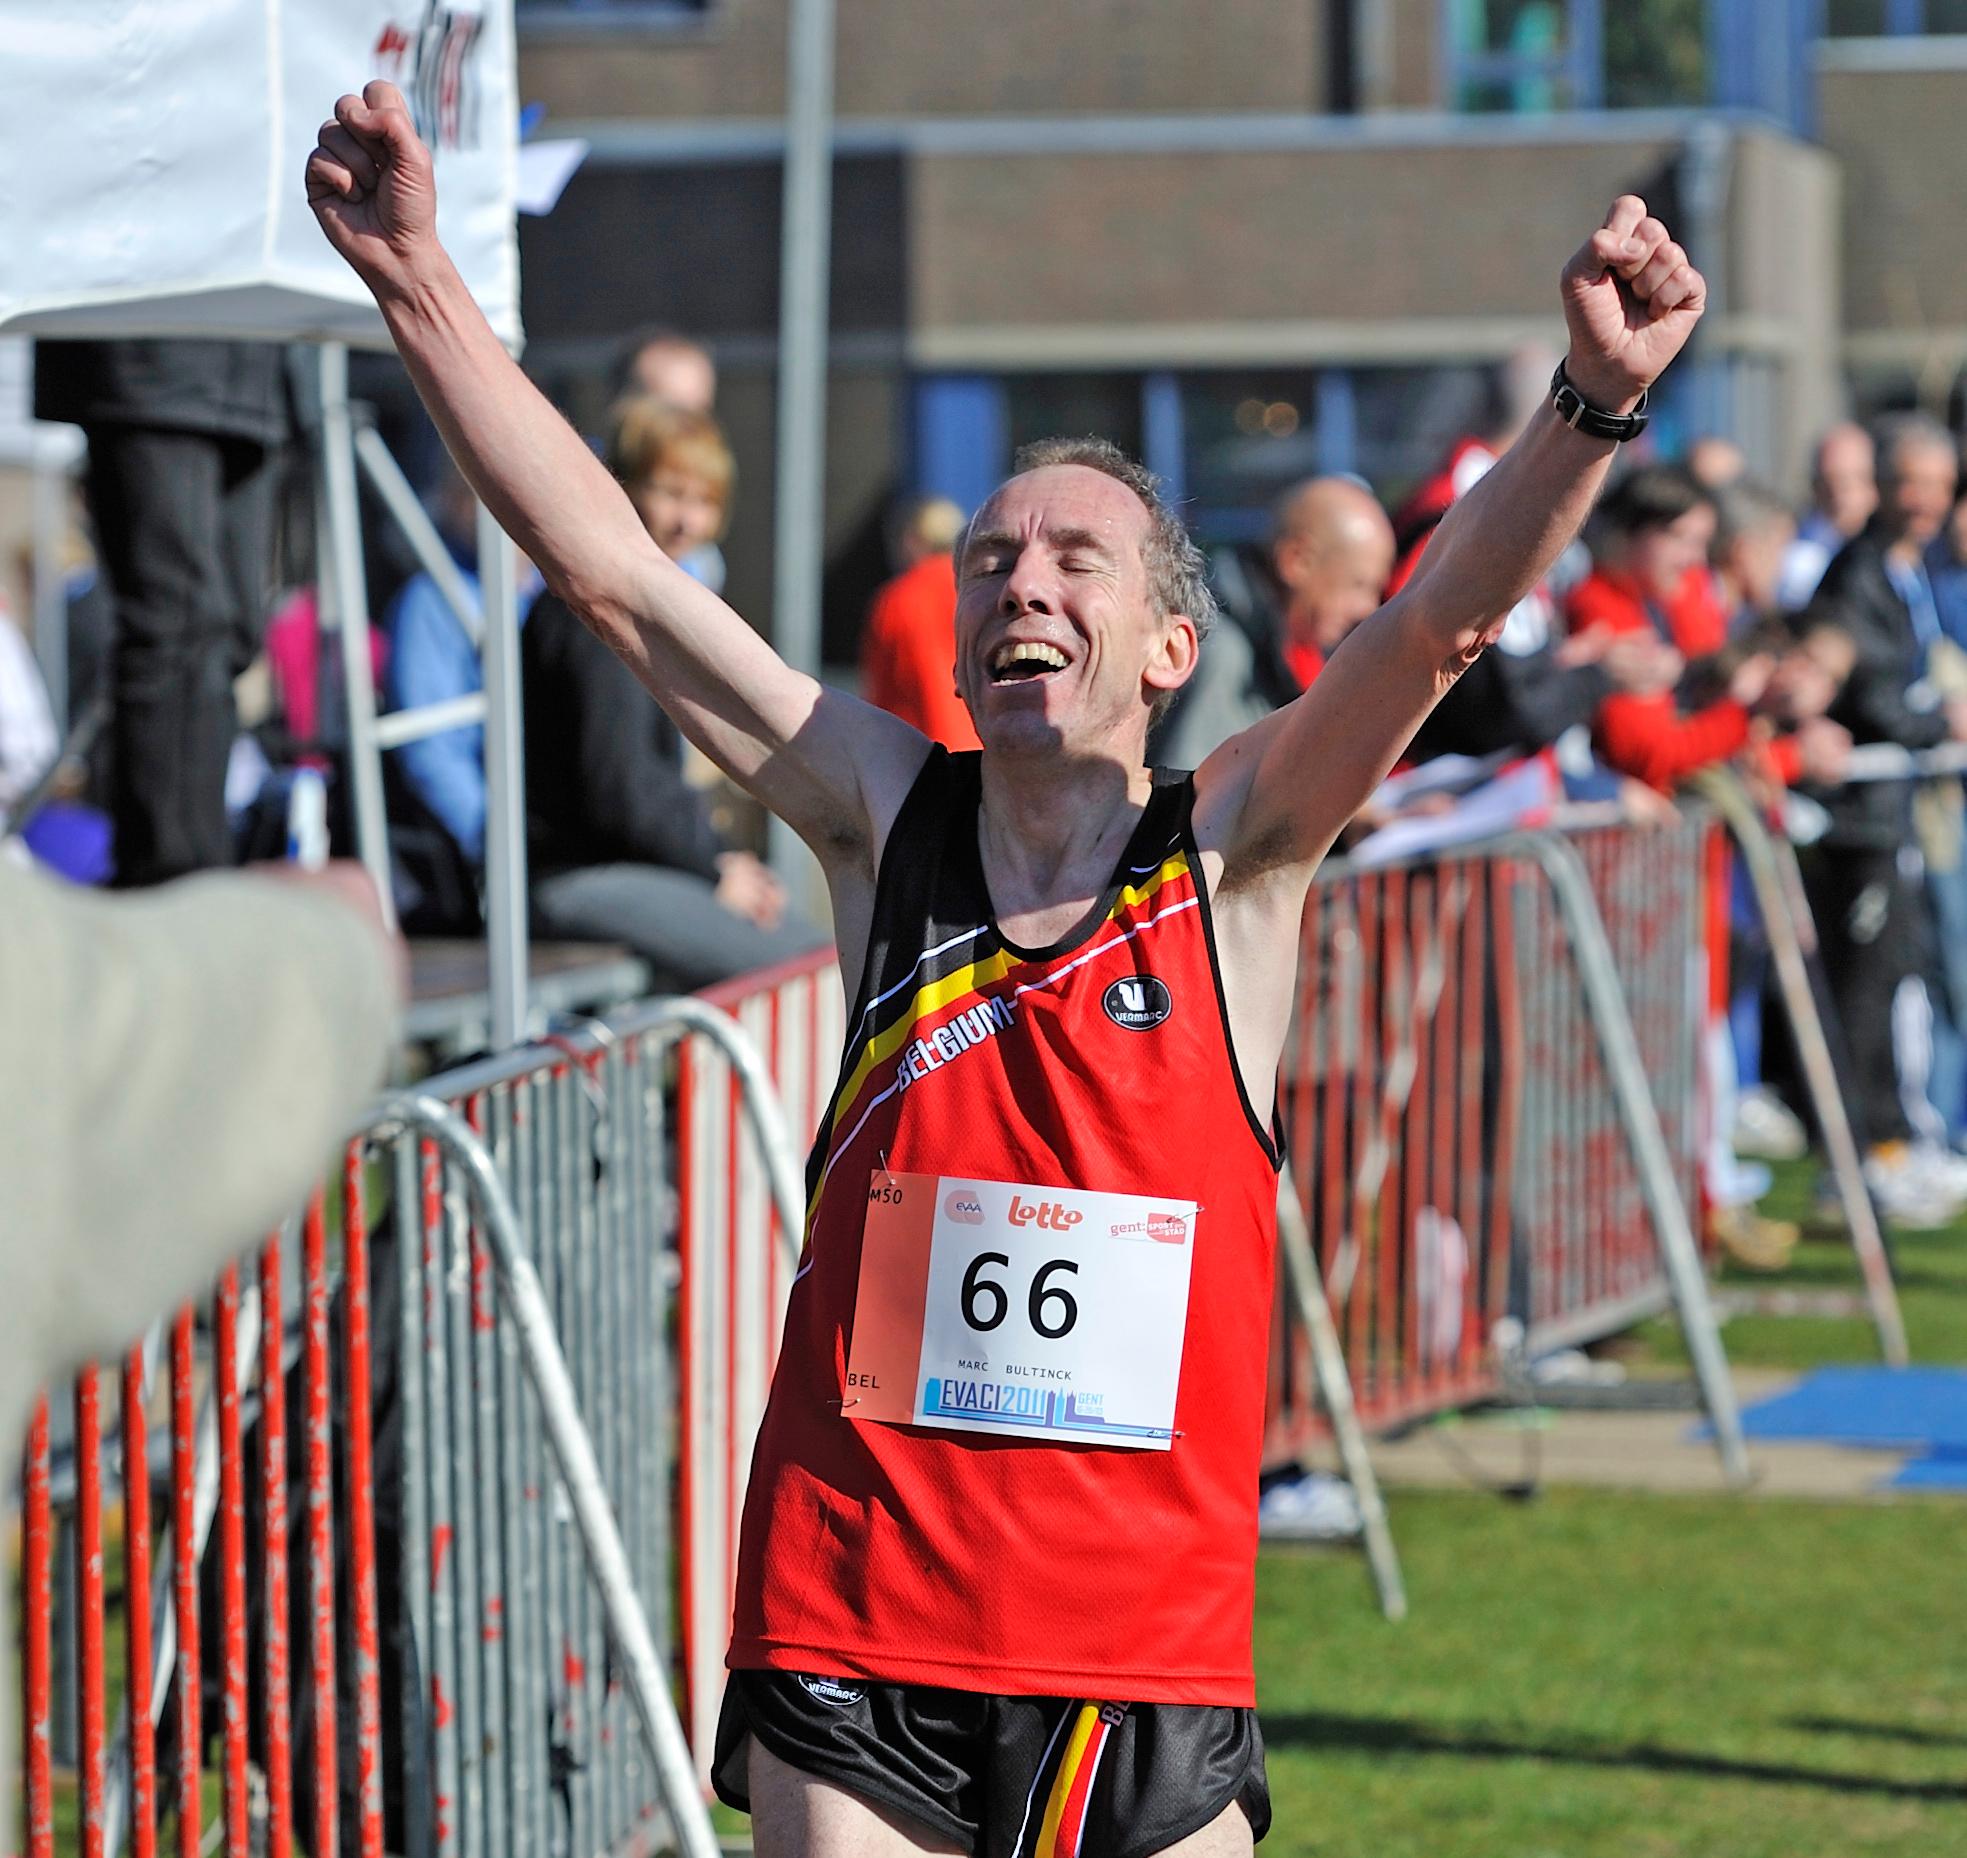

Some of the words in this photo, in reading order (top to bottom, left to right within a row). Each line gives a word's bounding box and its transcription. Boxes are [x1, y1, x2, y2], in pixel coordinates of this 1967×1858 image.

[897, 995, 1015, 1092] BELGIUM
[869, 1189, 902, 1204] M50
[960, 1251, 1079, 1339] 66
[958, 1360, 989, 1372] MARC
[1006, 1365, 1072, 1380] BULTINCK
[848, 1373, 881, 1389] BEL
